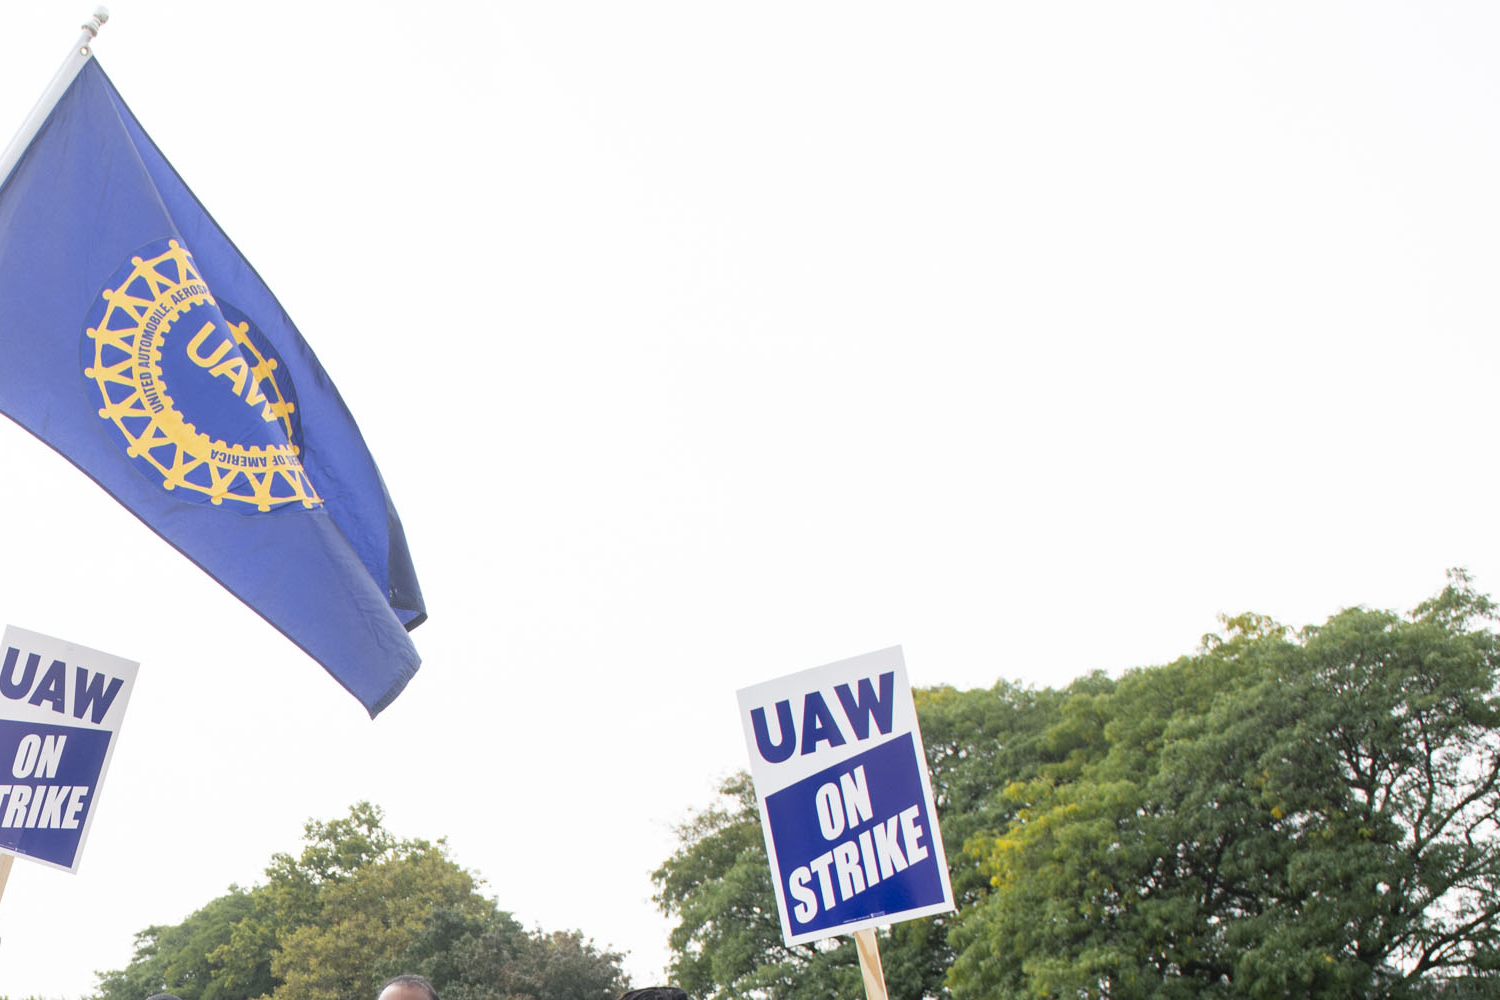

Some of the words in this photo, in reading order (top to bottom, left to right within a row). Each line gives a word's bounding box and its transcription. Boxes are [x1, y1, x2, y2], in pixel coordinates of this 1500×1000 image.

[138, 302, 174, 369] AUTOMOBILE,
[140, 369, 165, 414] UNITED
[210, 448, 267, 468] AMERICA
[272, 455, 286, 466] OF
[0, 646, 125, 725] UAW
[750, 670, 895, 764] UAW
[11, 734, 67, 779] ON
[815, 764, 873, 841] ON
[788, 804, 929, 924] STRIKE
